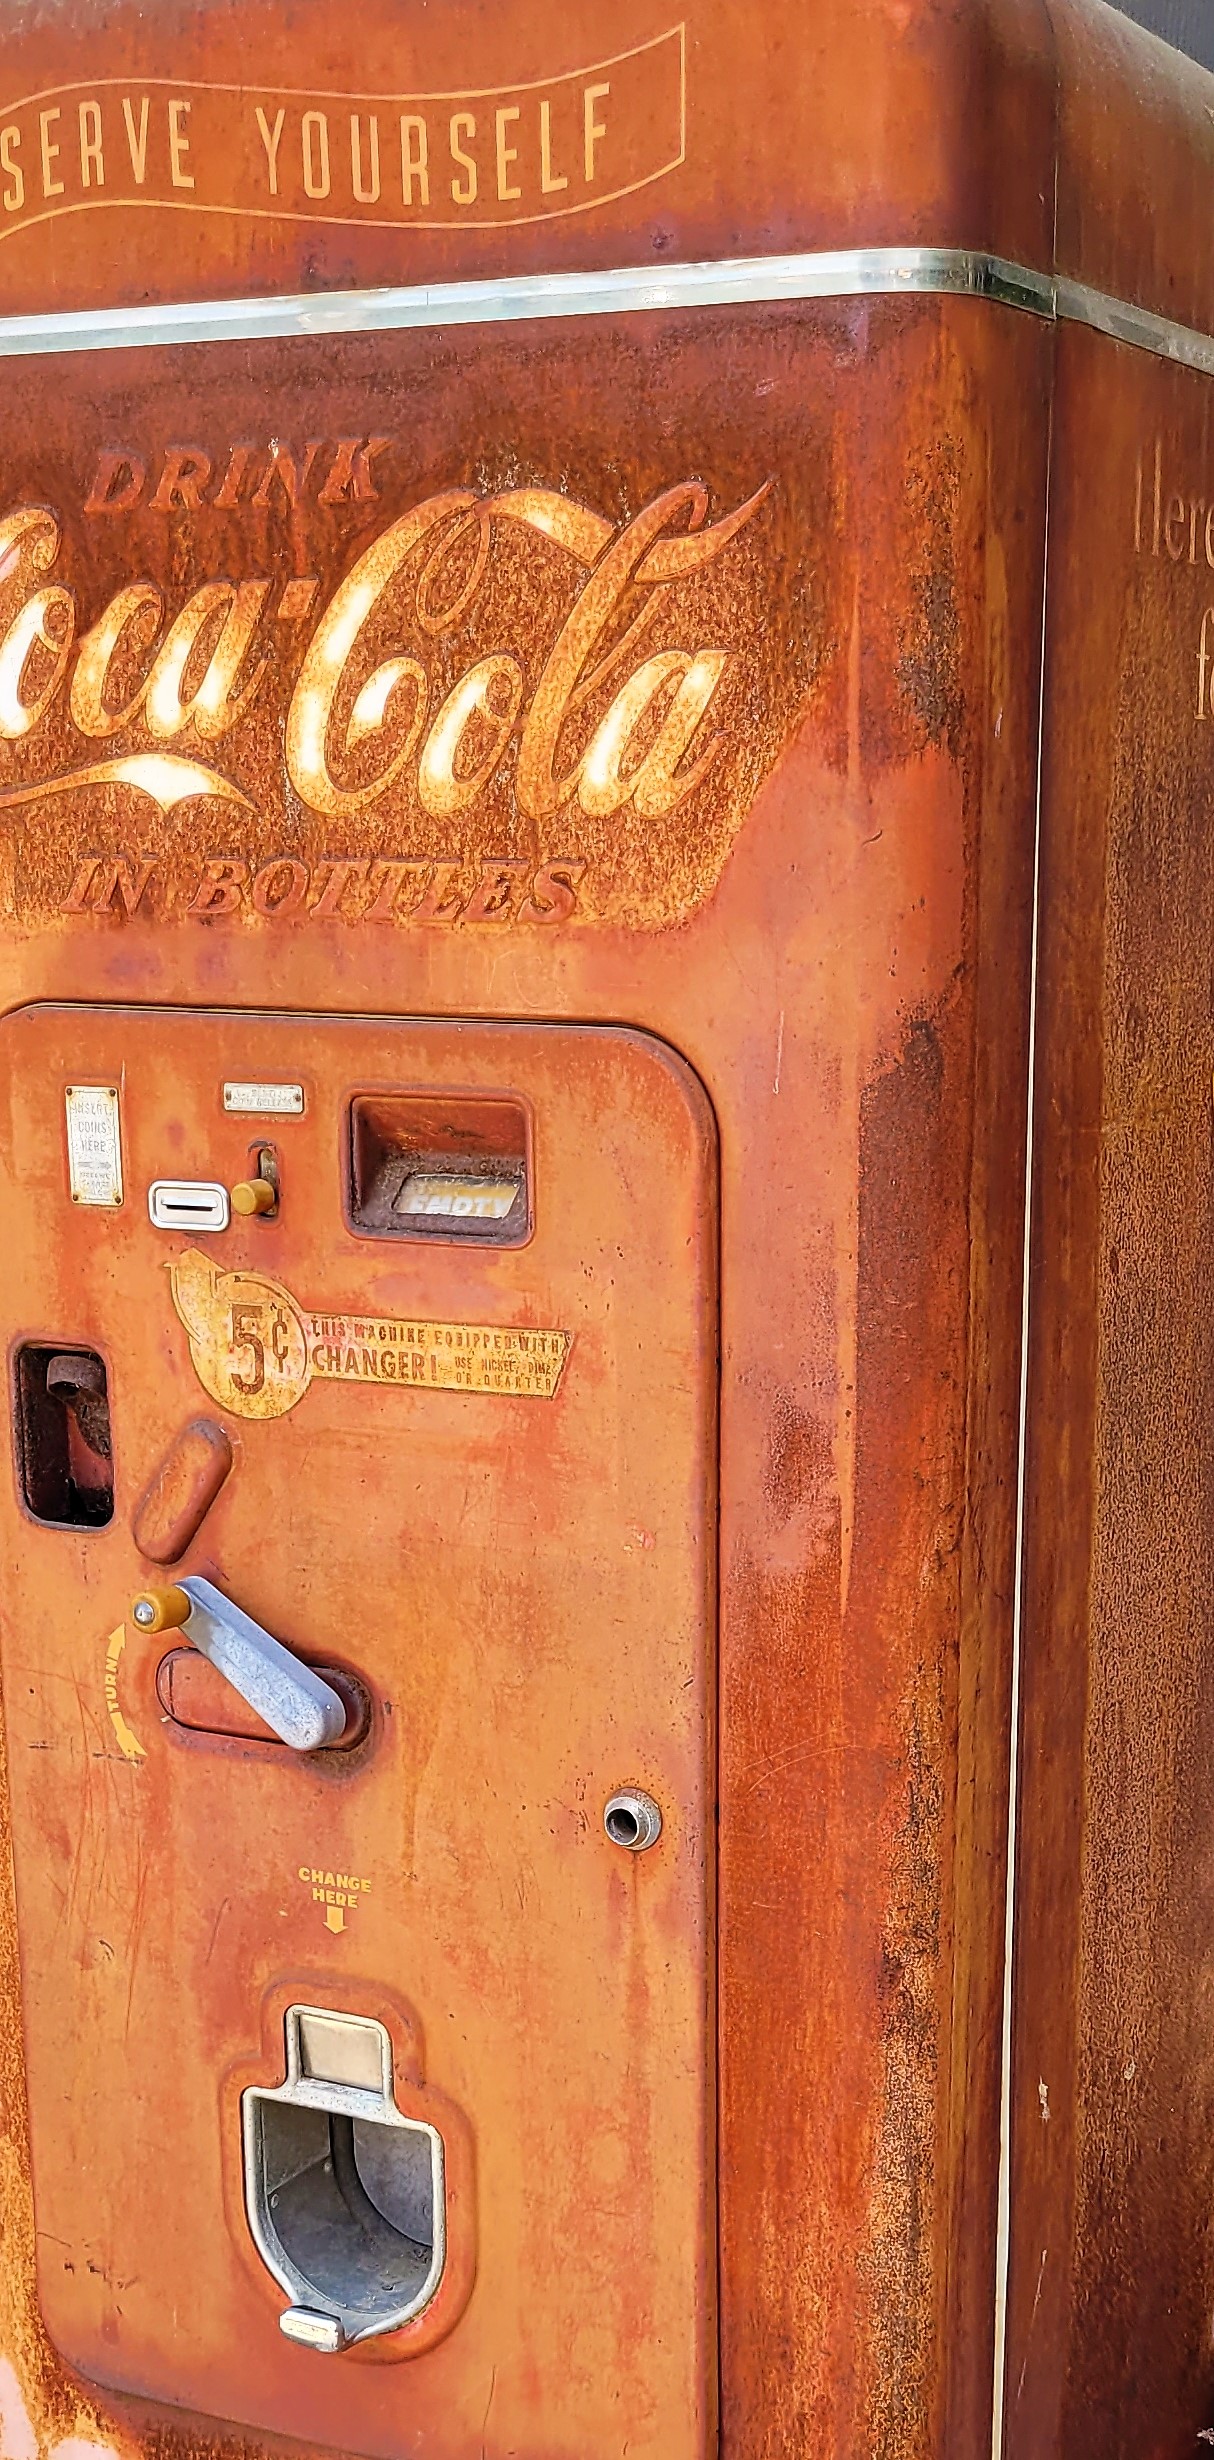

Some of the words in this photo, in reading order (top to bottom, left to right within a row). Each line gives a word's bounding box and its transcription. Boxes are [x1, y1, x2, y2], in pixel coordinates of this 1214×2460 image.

[0, 98, 195, 212] SERVE
[256, 82, 611, 206] YOURSELF
[84, 436, 393, 513] DRINK
[61, 854, 160, 917] IN
[186, 857, 586, 923] BOTTLES
[78, 1121, 107, 1134] COINS
[81, 1140, 107, 1153] HERE
[311, 1318, 346, 1337] THIS
[354, 1323, 425, 1344] MACHINE
[434, 1330, 512, 1350] EQUIPPED
[519, 1334, 559, 1354] WITH
[311, 1344, 437, 1381] CHANGER!
[454, 1356, 472, 1370] USE
[456, 1371, 472, 1385] OR
[484, 1374, 551, 1391] QUARTER
[105, 1655, 120, 1713] TURN
[298, 1867, 372, 1893] CHANGE
[312, 1887, 358, 1909] HERE
